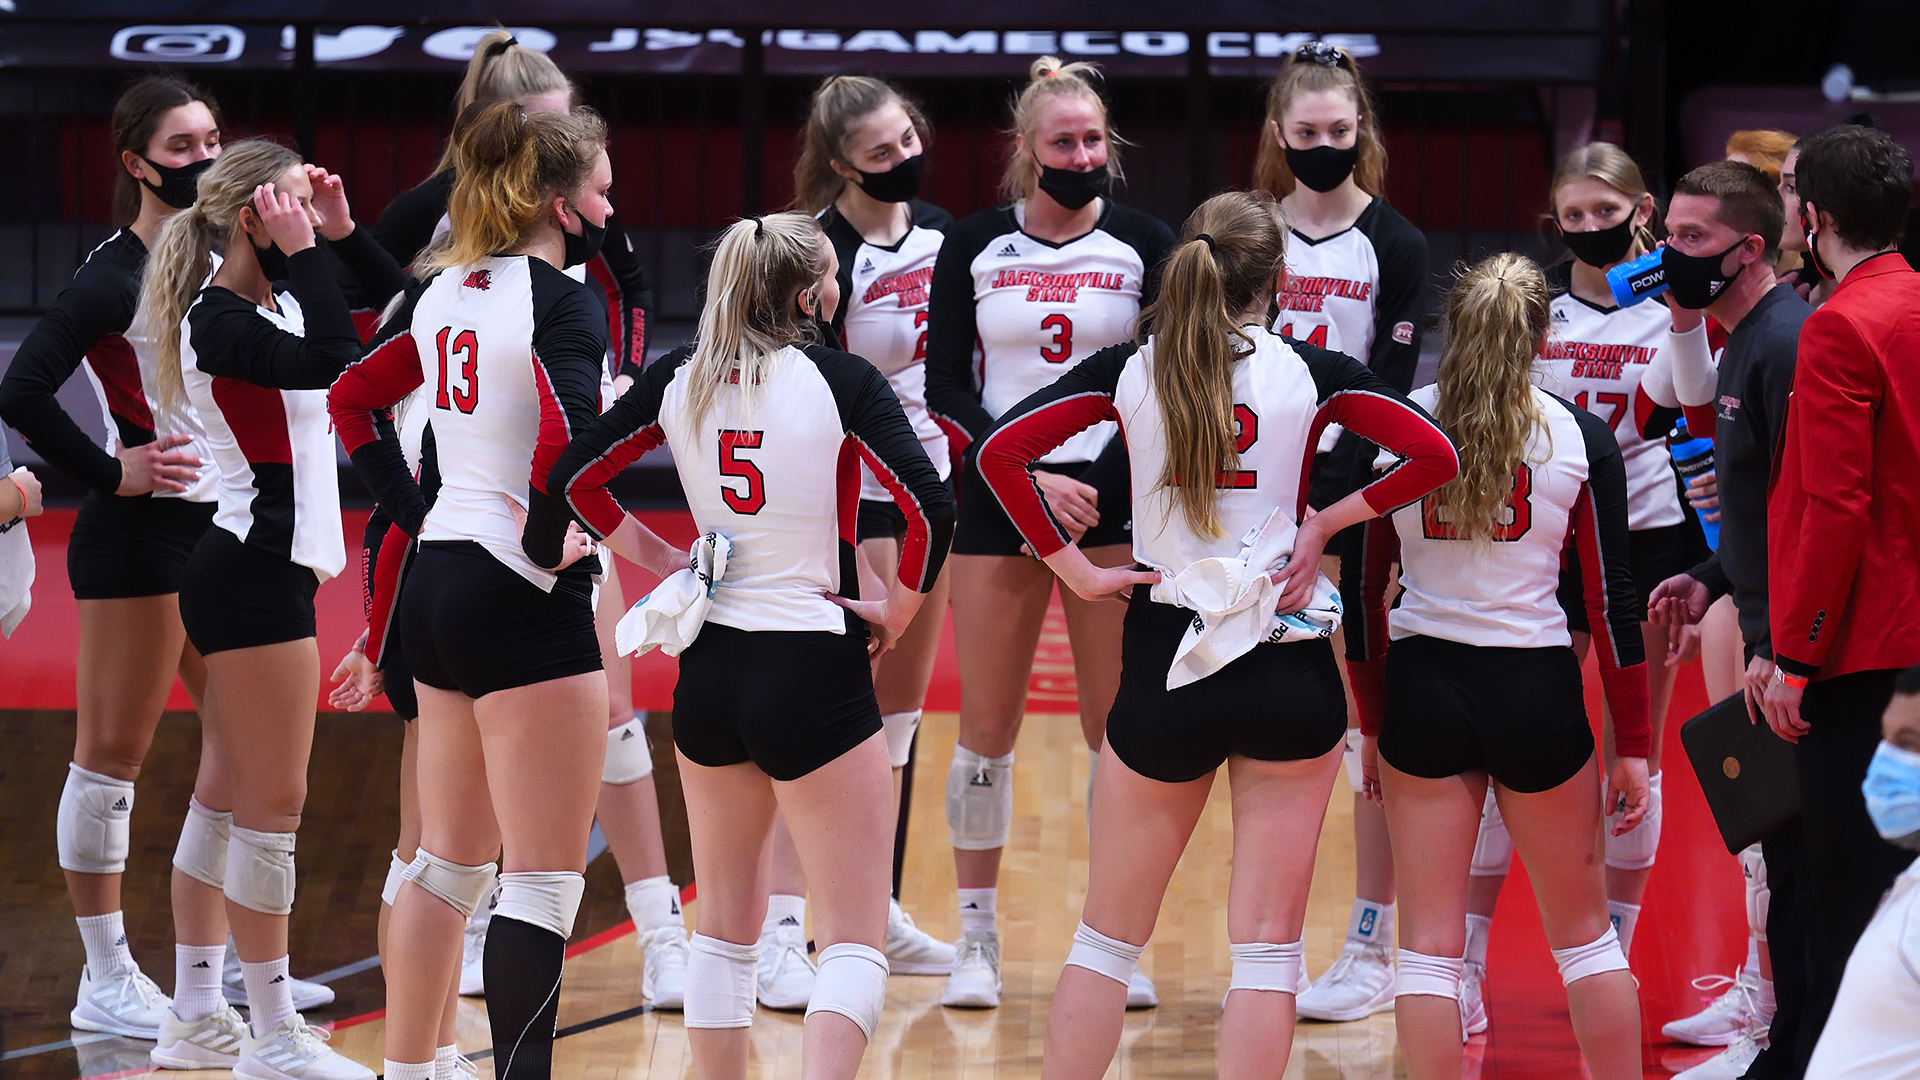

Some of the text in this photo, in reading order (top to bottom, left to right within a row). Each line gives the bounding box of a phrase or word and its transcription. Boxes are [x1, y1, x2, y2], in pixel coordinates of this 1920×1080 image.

[992, 270, 1124, 290] JACKSONVILLE
[1281, 275, 1371, 301] SONVILLE
[1026, 285, 1079, 303] STATE
[1277, 292, 1326, 313] STATE
[1040, 313, 1073, 364] 3
[1540, 341, 1658, 365] JACKSONVIL
[436, 325, 479, 415] 13
[1571, 360, 1625, 380] STATE
[717, 428, 767, 515] 5
[1421, 458, 1532, 542] 3
